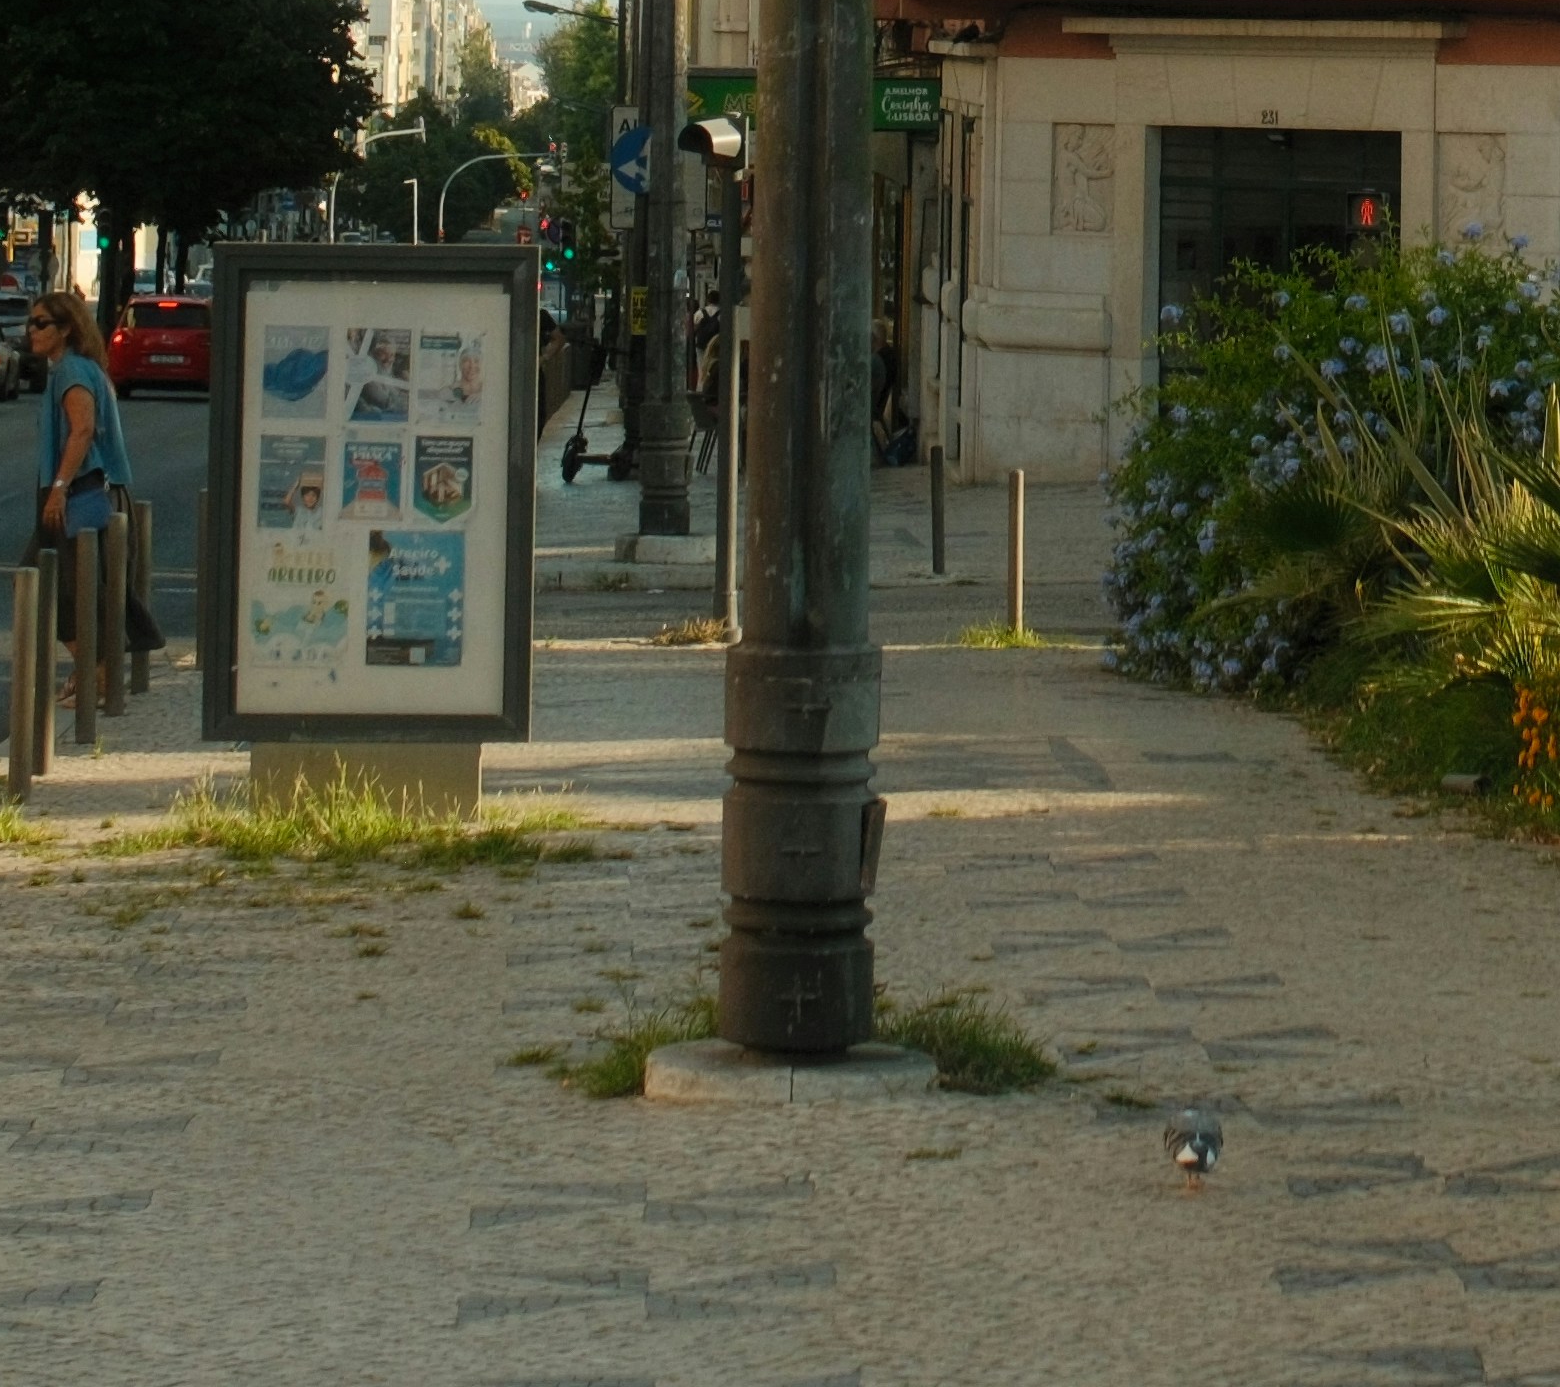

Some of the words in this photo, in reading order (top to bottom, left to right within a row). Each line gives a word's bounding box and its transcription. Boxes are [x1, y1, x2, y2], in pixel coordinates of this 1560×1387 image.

[892, 87, 928, 96] MELHOR
[894, 112, 931, 122] LISBOA
[1261, 109, 1279, 125] 231
